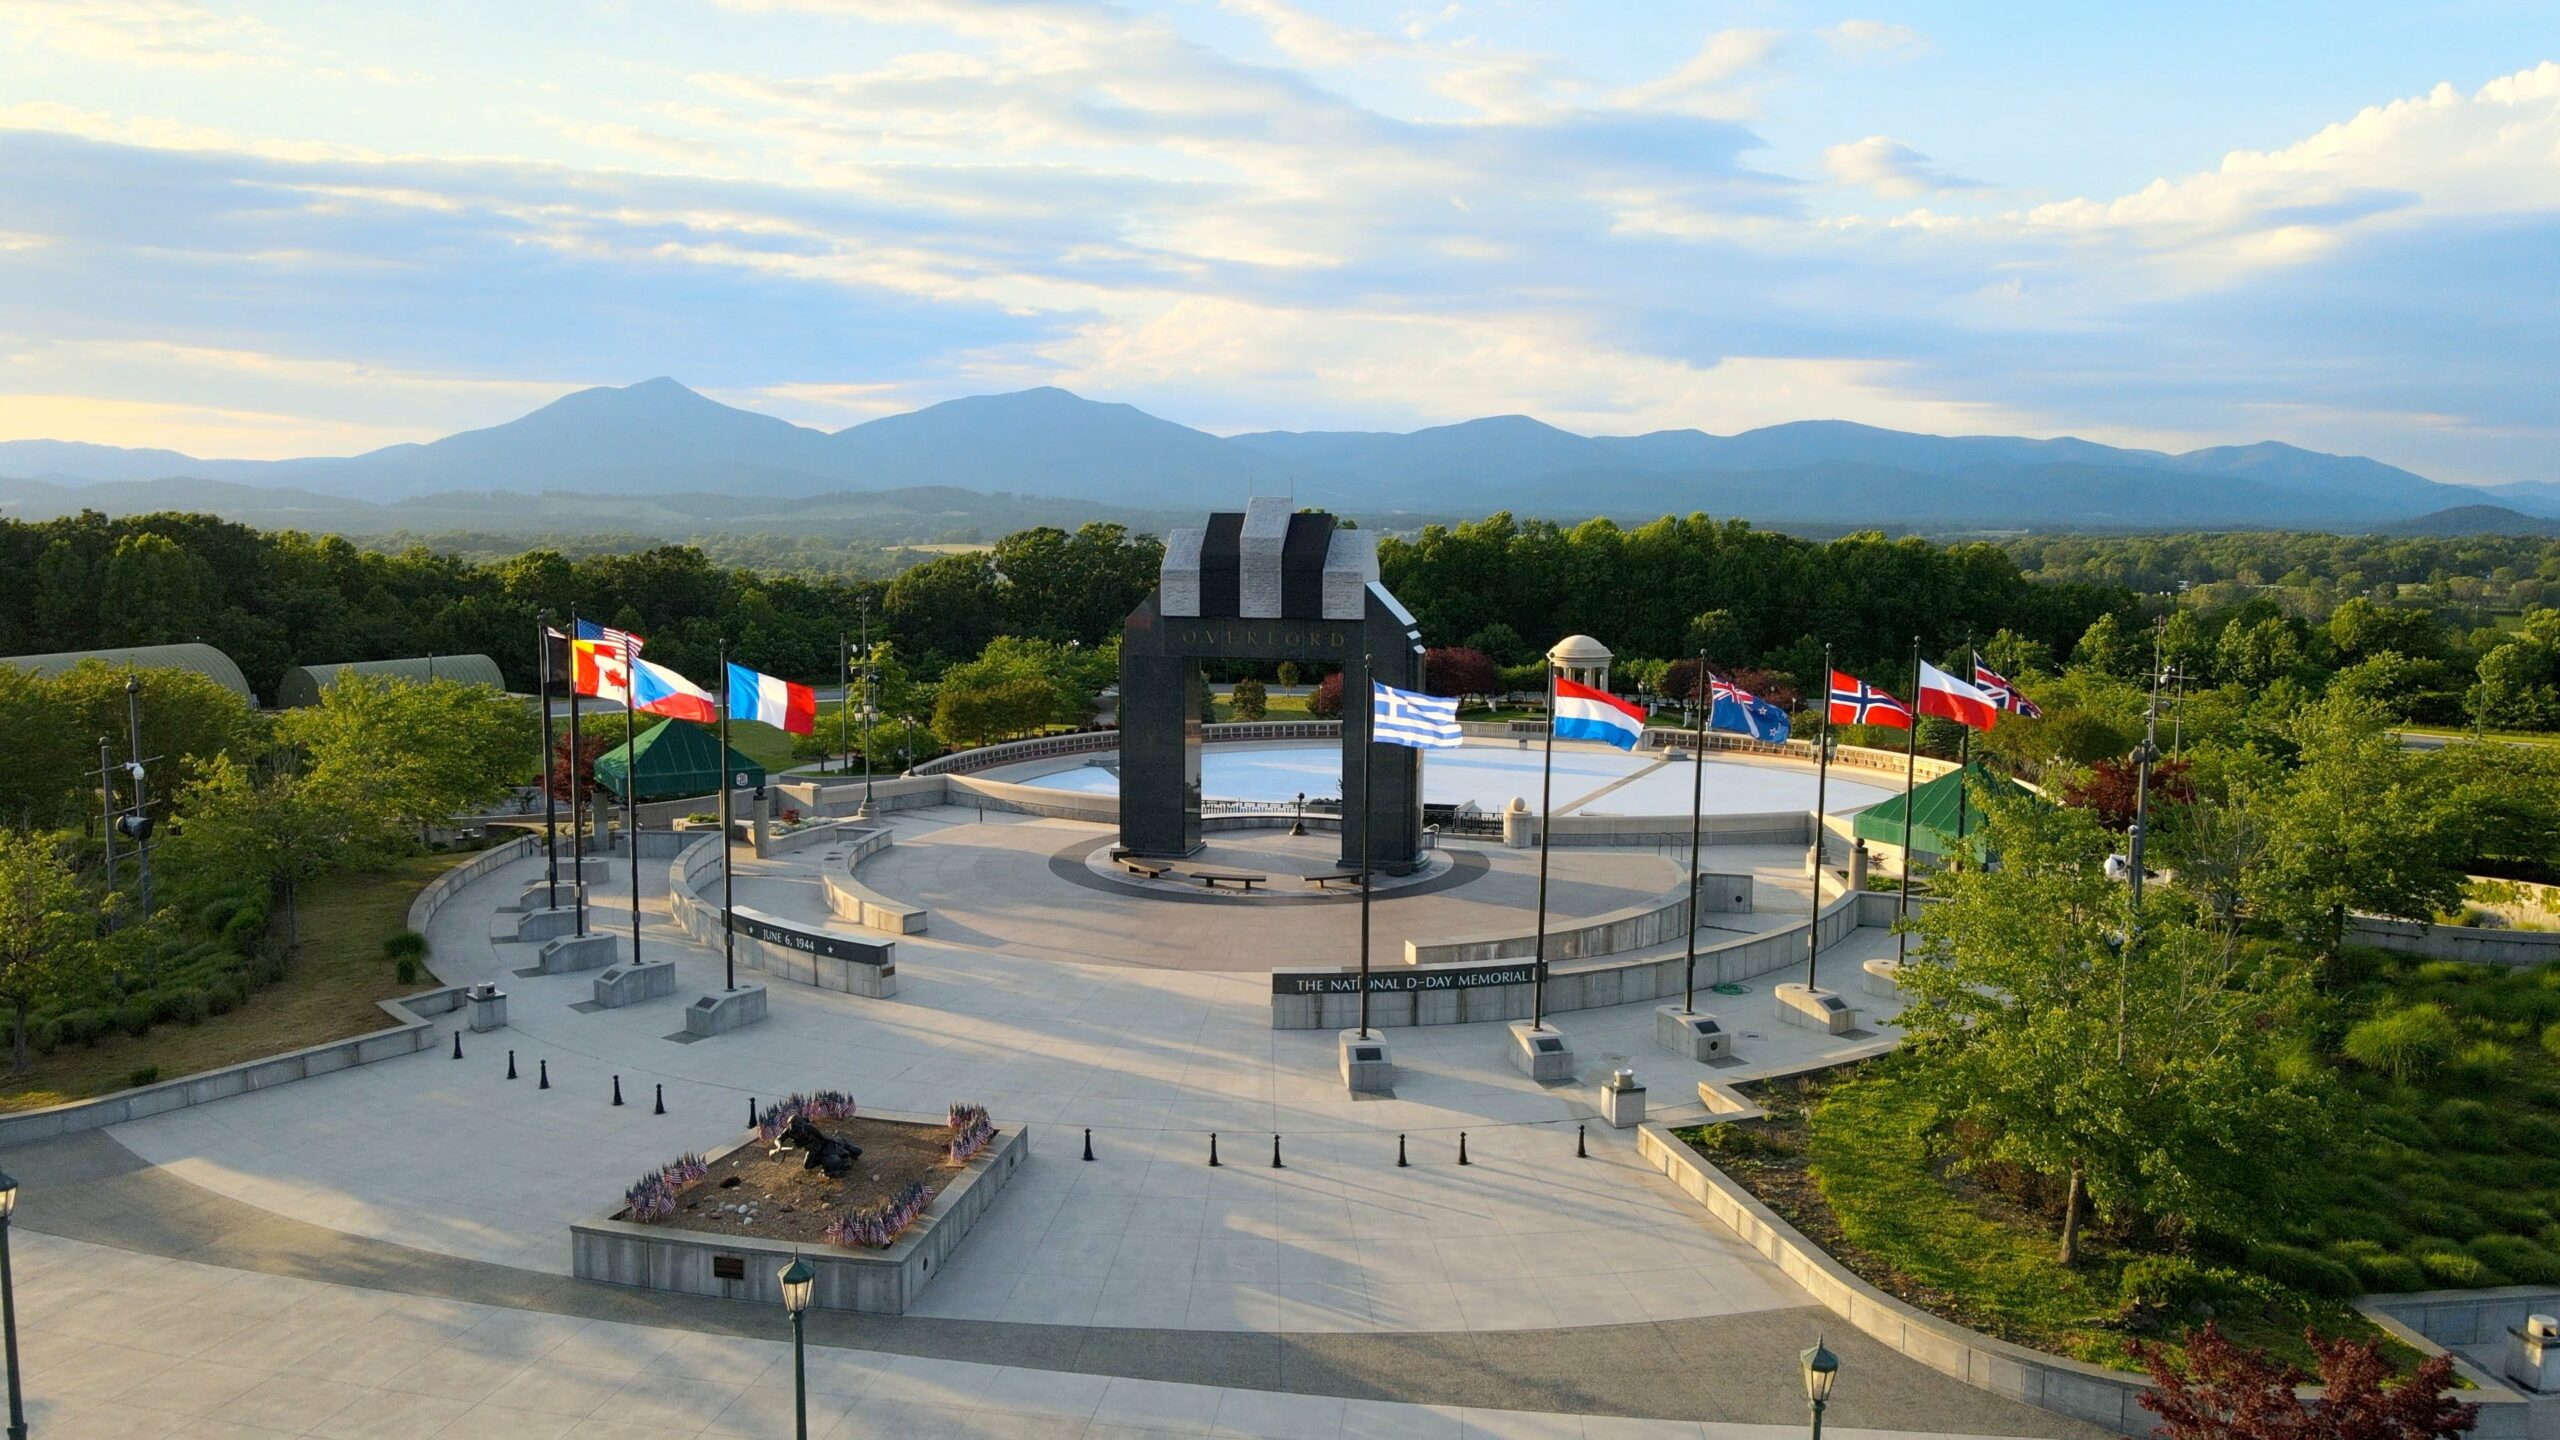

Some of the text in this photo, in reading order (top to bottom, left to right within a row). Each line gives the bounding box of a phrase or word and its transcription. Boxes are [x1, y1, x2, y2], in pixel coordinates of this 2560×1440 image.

[1182, 630, 1346, 647] OVERLORD
[763, 929, 815, 951] JUNE 6, 1944
[1297, 979, 1324, 992] THE
[1406, 975, 1453, 988] D-DAY
[1458, 971, 1528, 986] MEMORIAL
